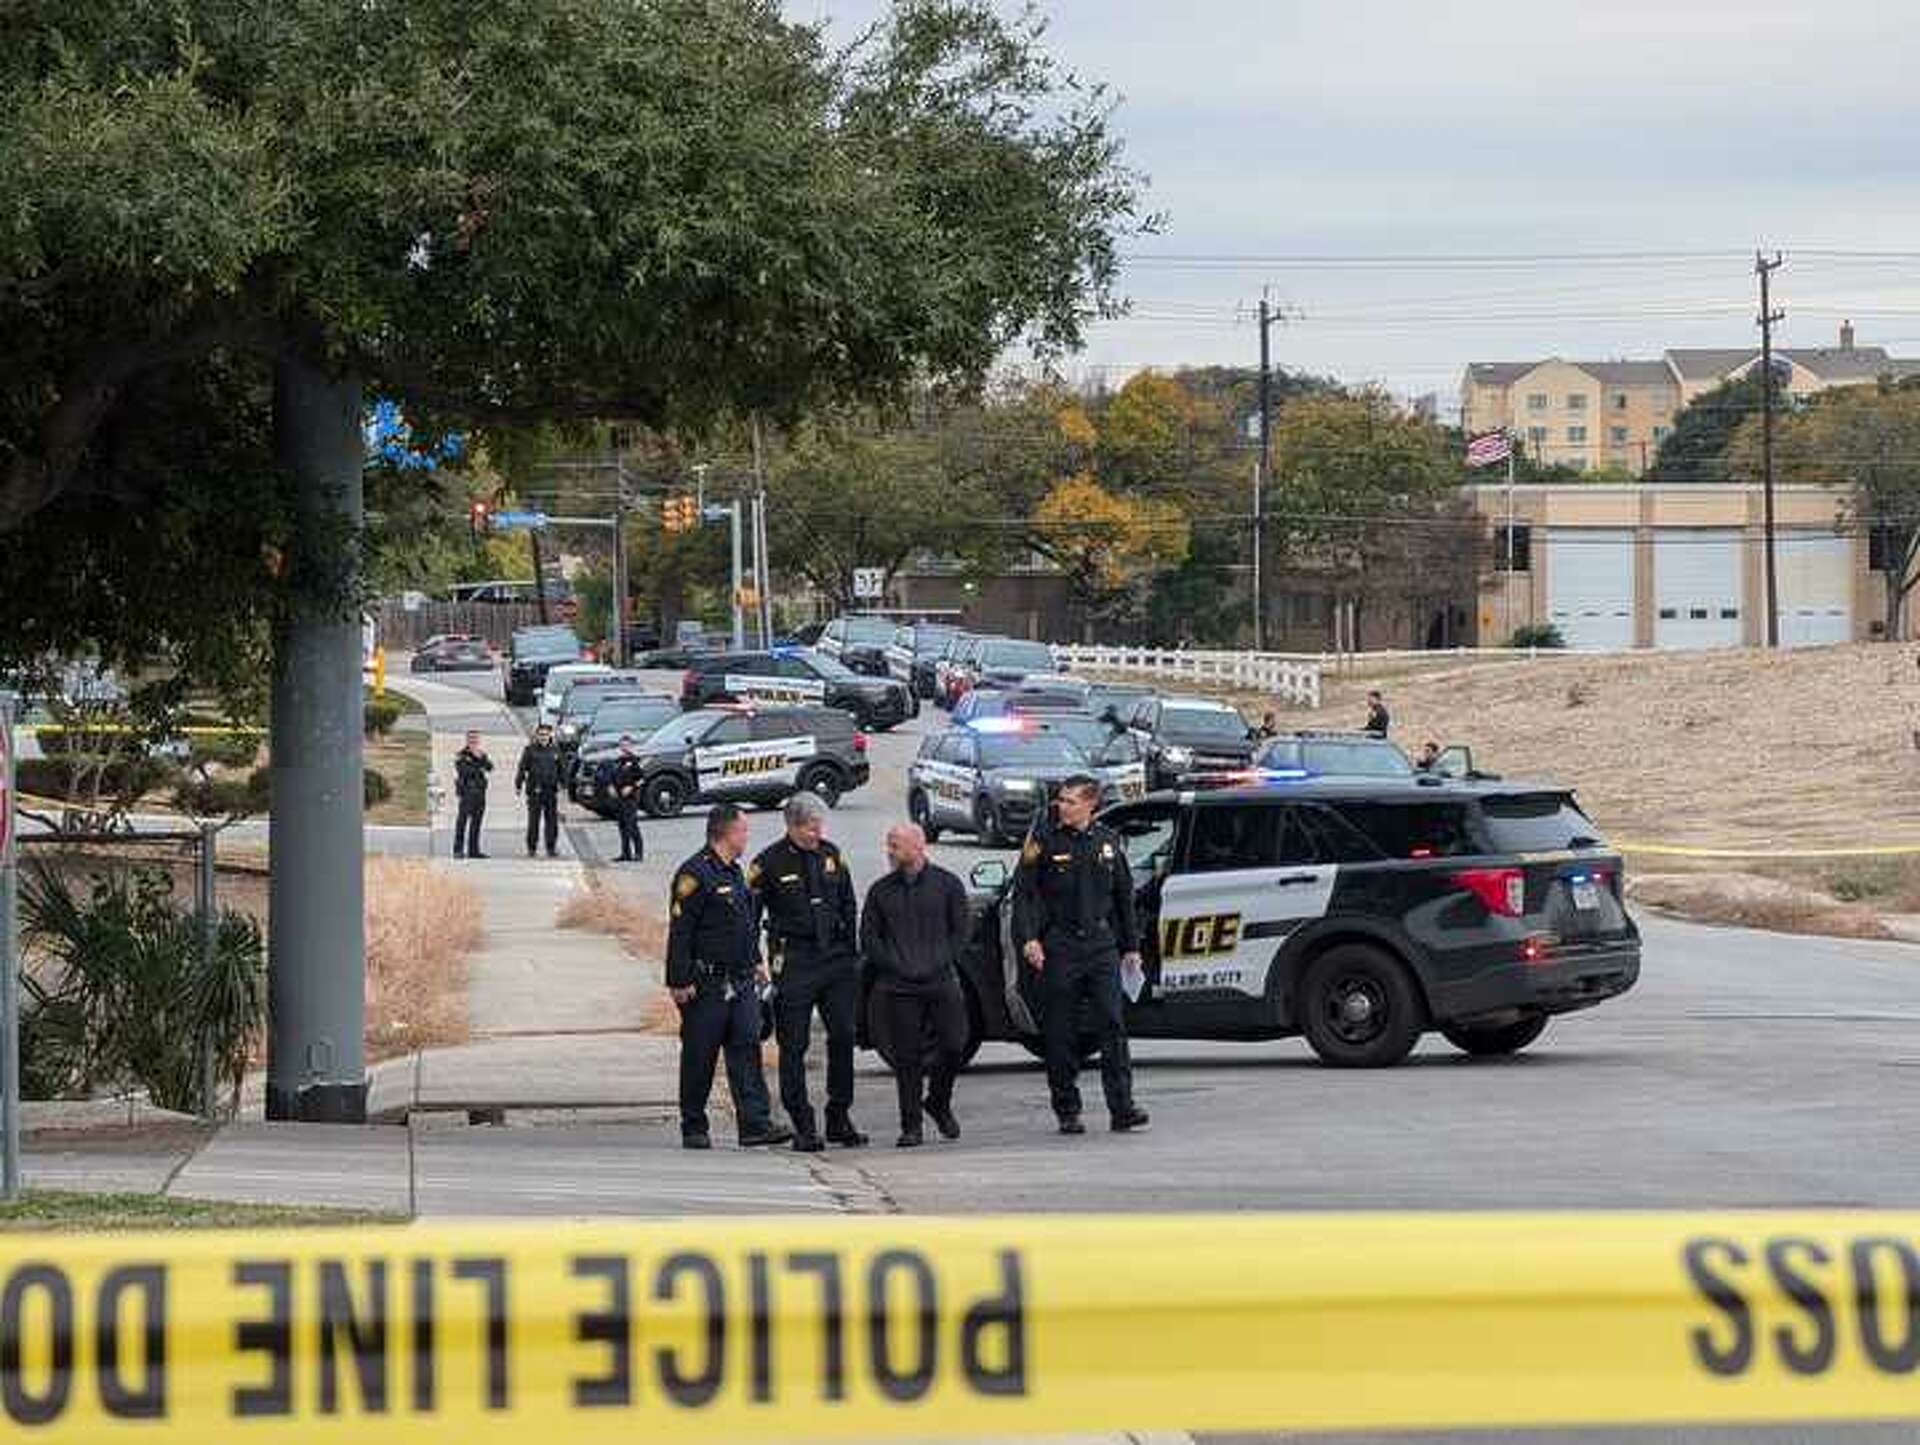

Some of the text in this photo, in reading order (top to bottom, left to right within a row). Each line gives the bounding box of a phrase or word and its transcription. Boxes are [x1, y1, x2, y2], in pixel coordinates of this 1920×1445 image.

[722, 754, 788, 777] POLICE
[0, 1262, 169, 1427] DO
[229, 1256, 513, 1418] LINE
[570, 1247, 1029, 1410] POLICE
